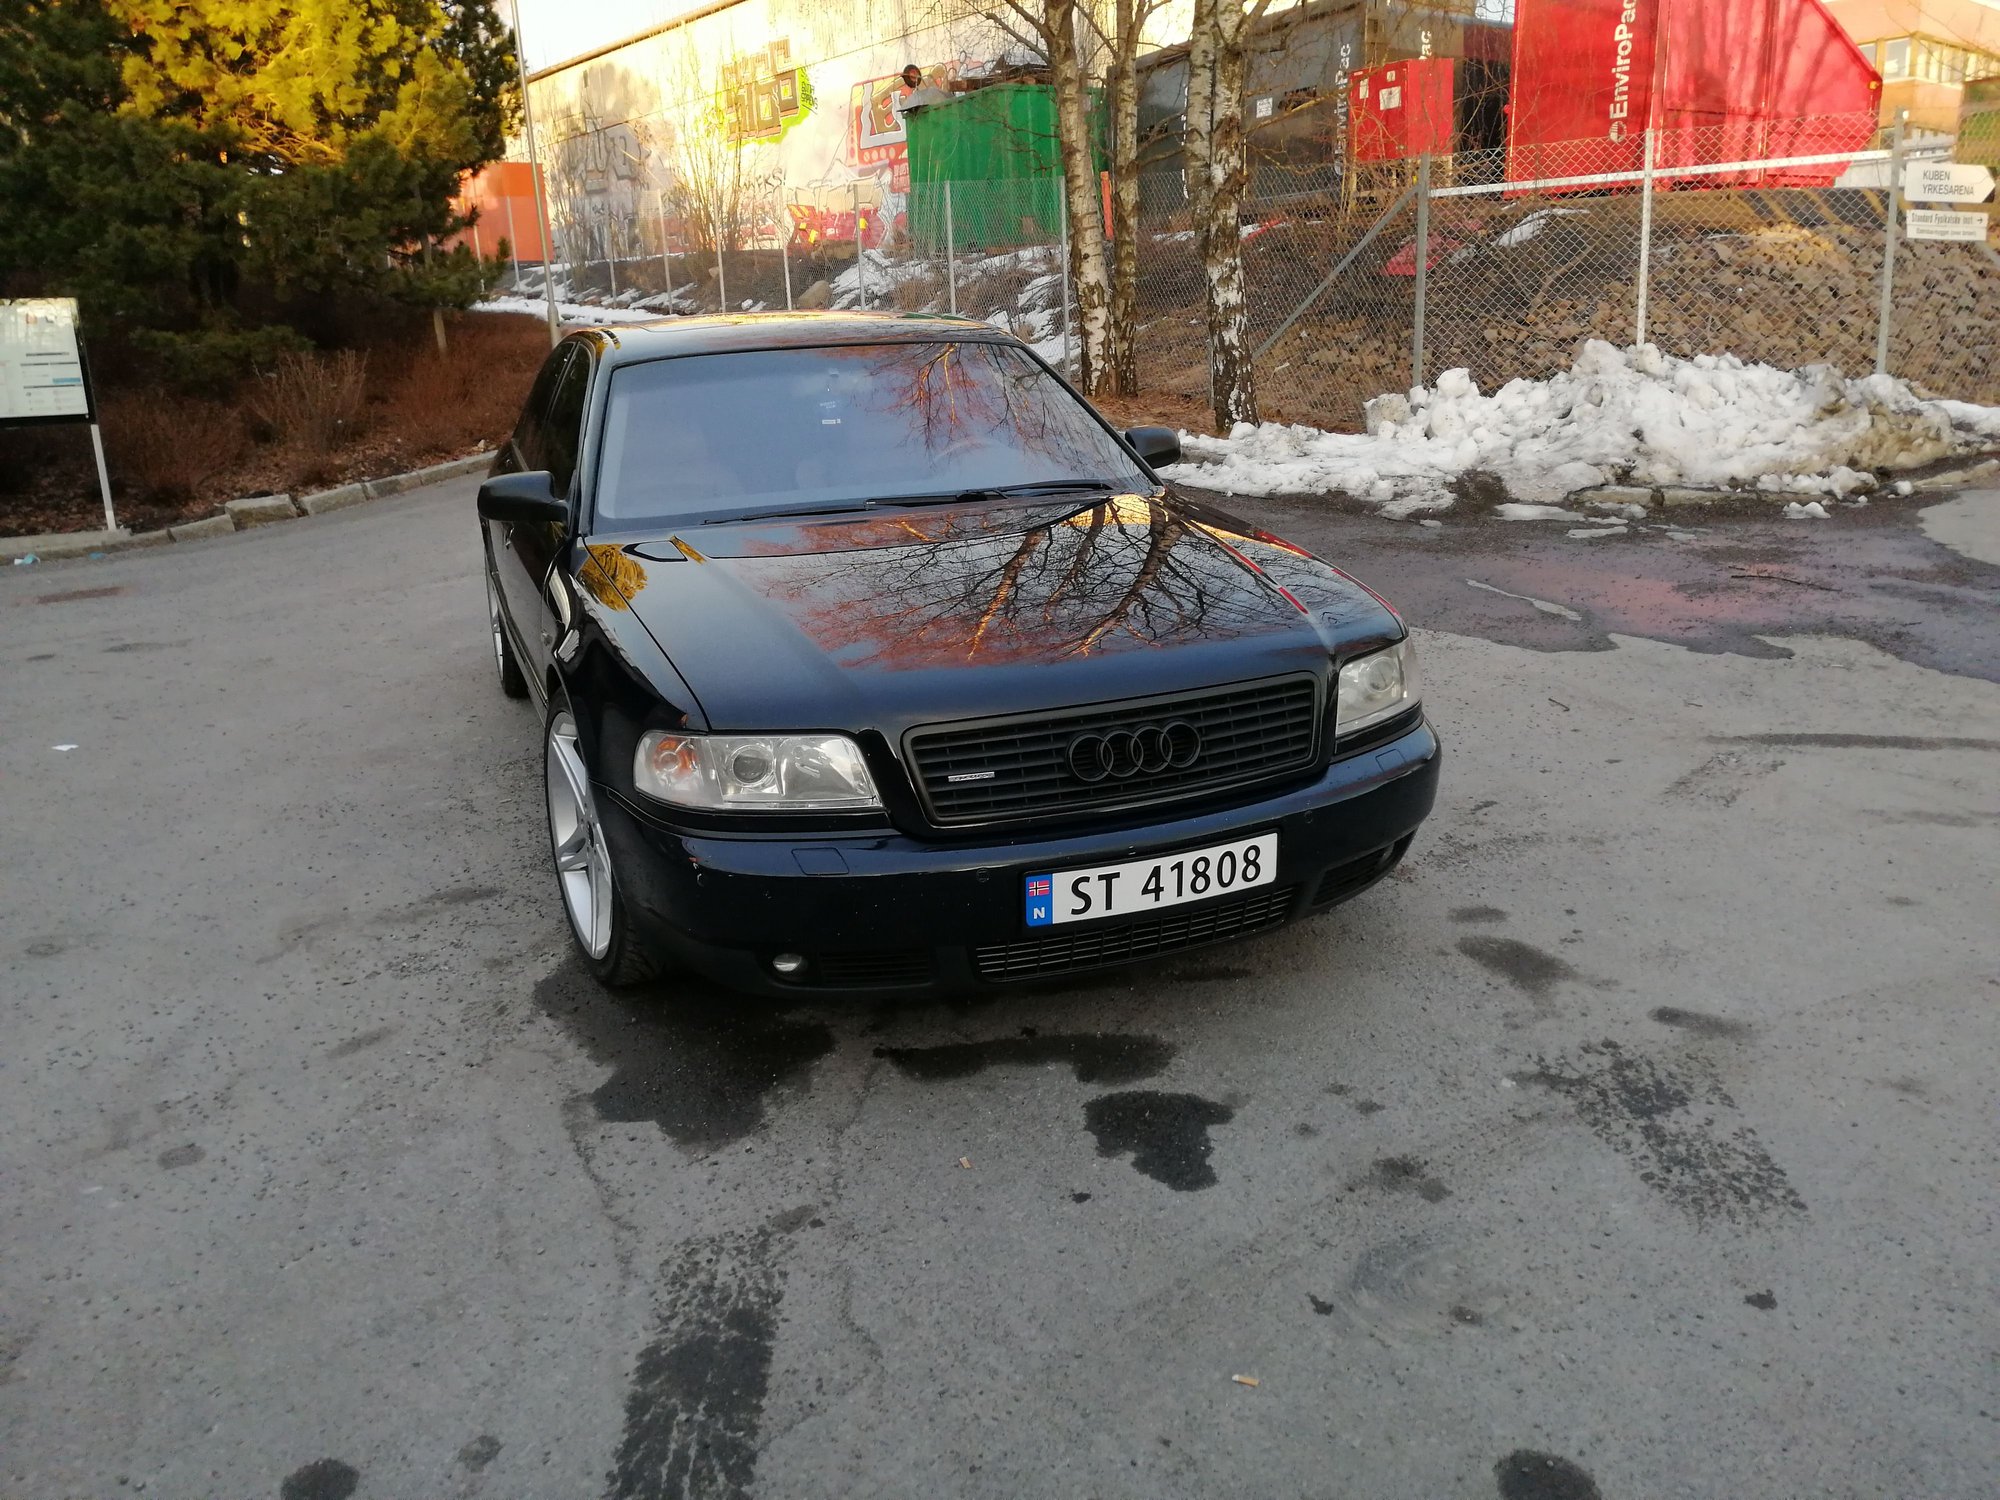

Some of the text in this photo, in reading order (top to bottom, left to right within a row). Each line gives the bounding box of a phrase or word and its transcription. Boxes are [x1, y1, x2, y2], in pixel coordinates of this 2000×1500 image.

[1923, 170, 1950, 181] KUBEN
[1923, 184, 1974, 195] YRKESARENA
[1070, 844, 1262, 916] ST 41808
[1032, 906, 1046, 920] N
